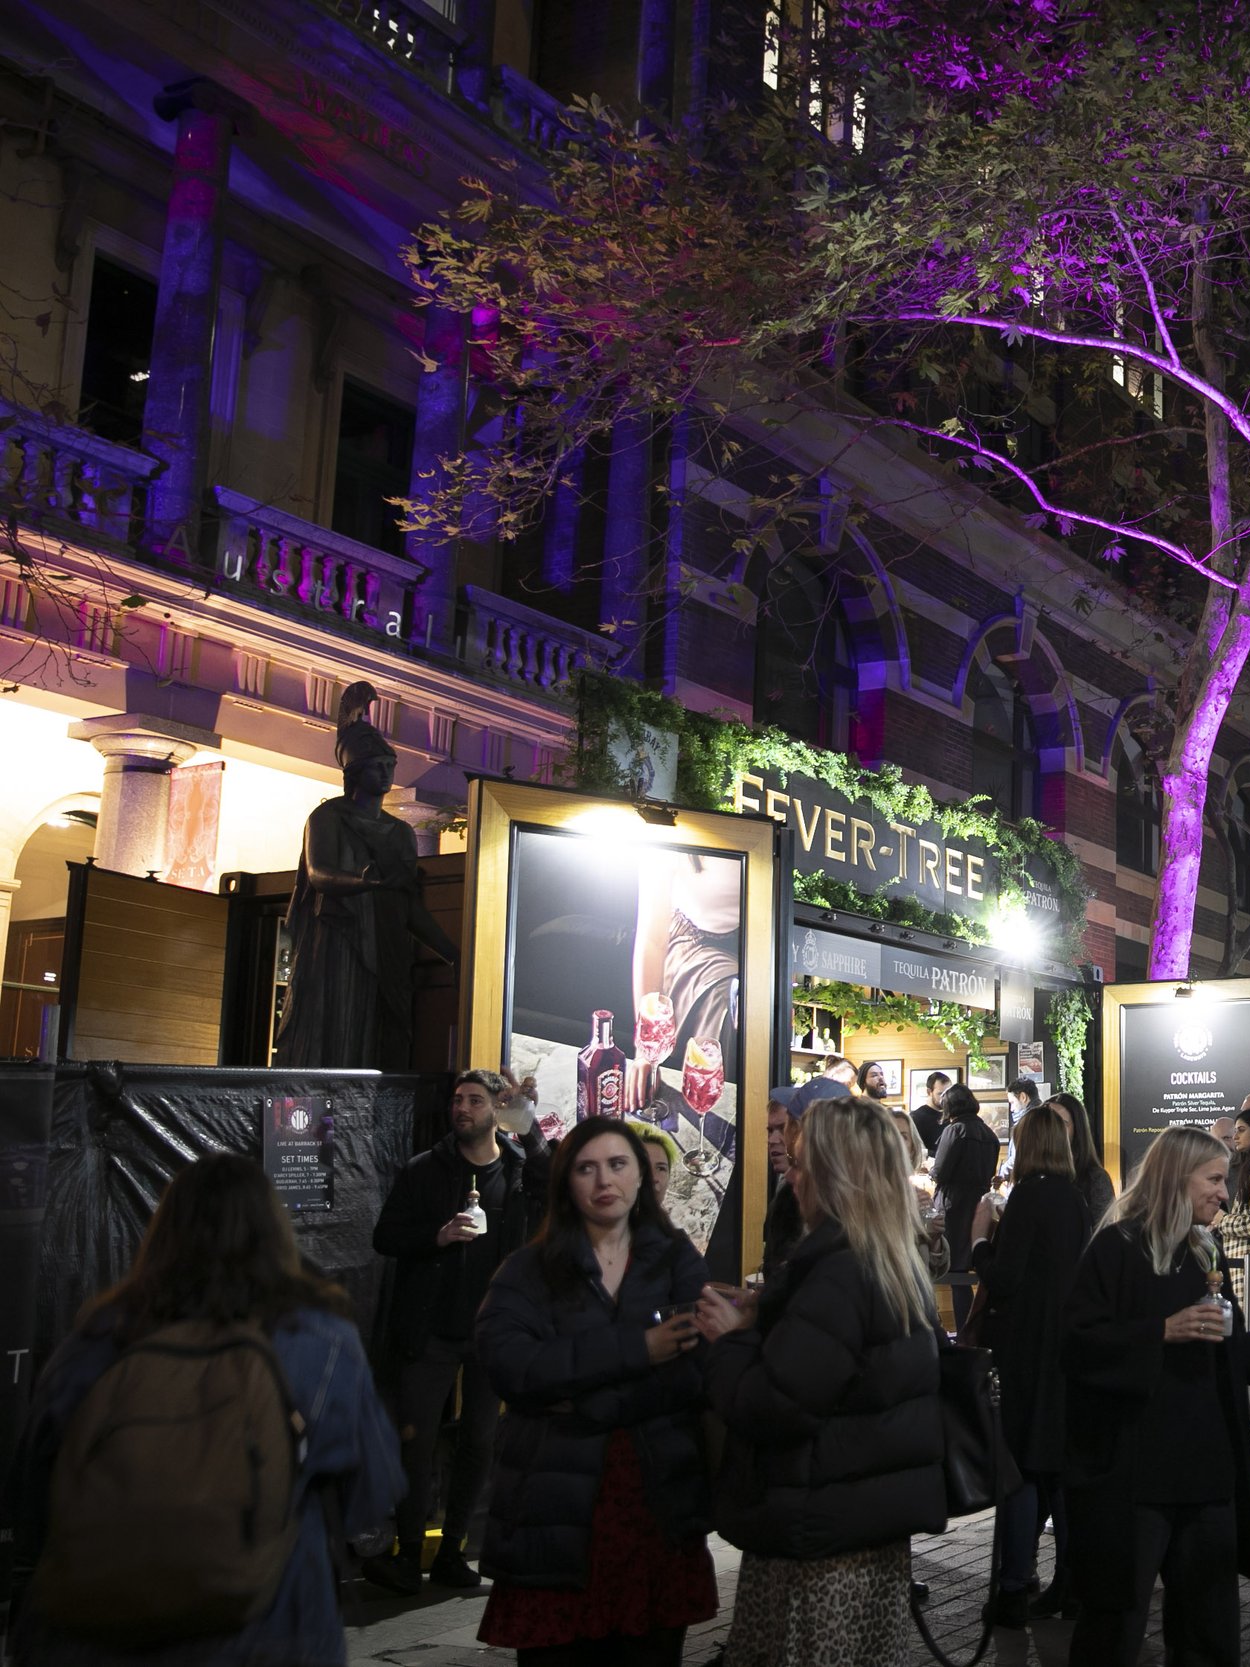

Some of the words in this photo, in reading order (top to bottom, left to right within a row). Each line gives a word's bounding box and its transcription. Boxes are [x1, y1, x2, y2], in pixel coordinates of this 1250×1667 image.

[893, 960, 930, 980] TEQUILA
[931, 969, 987, 998] PATRÓN
[1171, 1071, 1217, 1085] COCKTAILS
[1163, 1091, 1187, 1100] PATRÓN
[1188, 1091, 1225, 1099] MARGARITA
[281, 1155, 295, 1164] SET
[297, 1155, 319, 1164] TIMES
